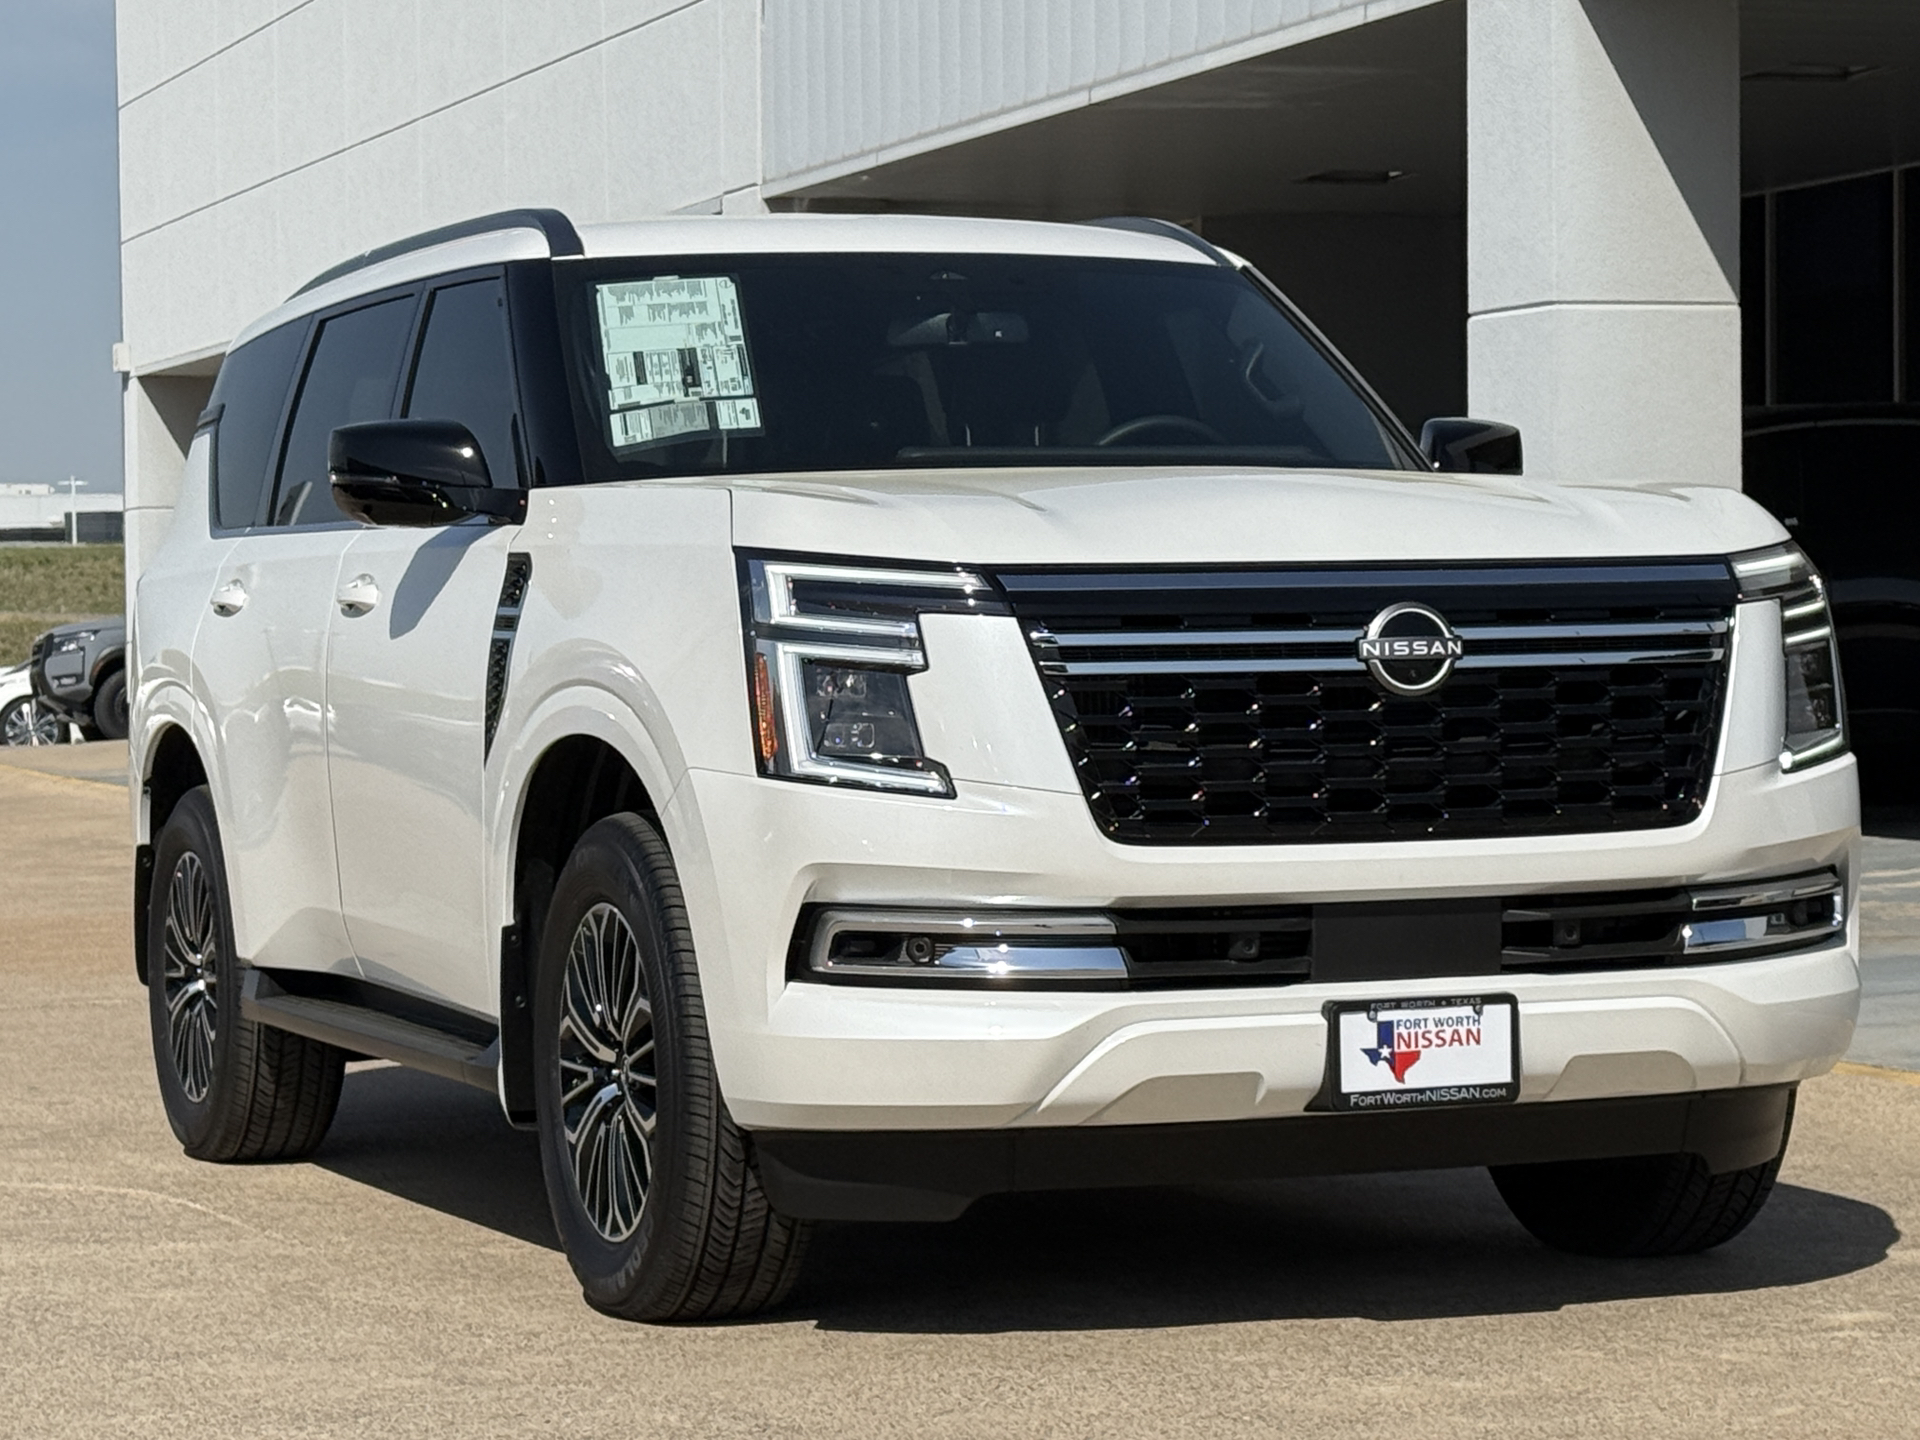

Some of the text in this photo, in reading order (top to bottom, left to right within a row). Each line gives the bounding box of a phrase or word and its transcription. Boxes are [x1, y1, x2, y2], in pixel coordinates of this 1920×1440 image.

[1362, 640, 1462, 657] NISSAN
[1370, 997, 1482, 1010] FORT WORTH TEXAS
[1396, 1014, 1481, 1031] FORT WORTH
[1396, 1027, 1481, 1050] NISSAN
